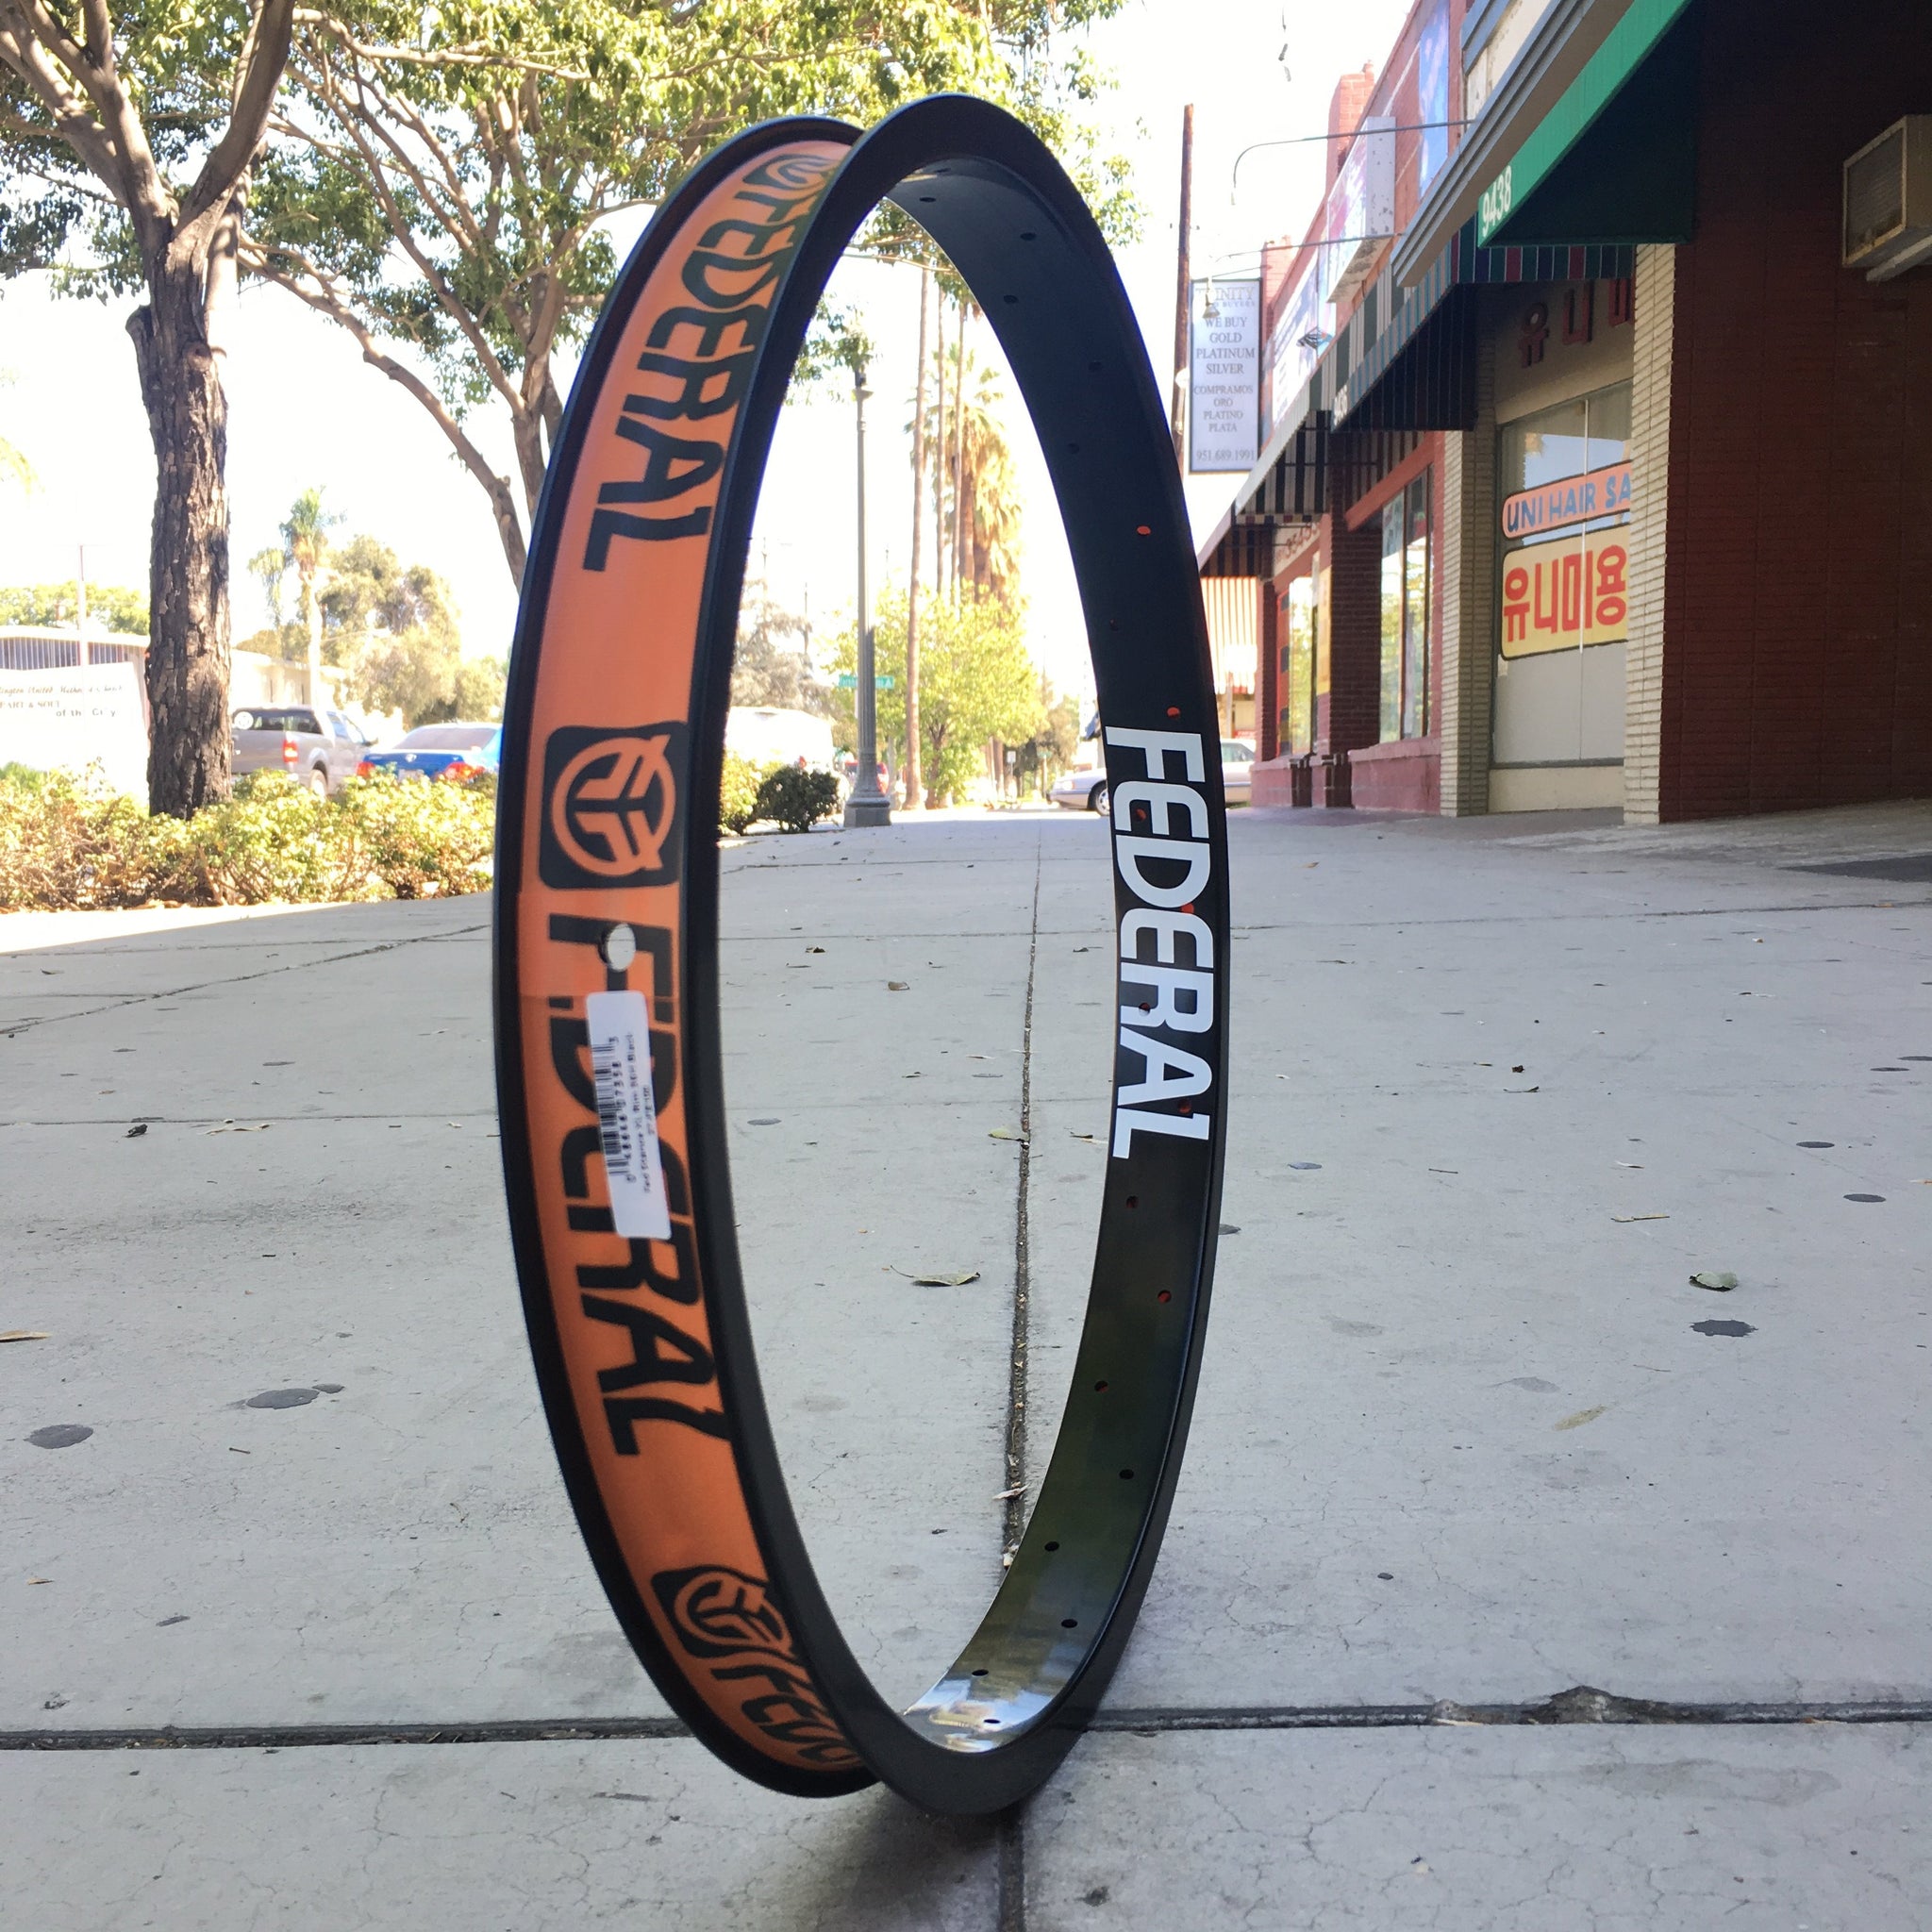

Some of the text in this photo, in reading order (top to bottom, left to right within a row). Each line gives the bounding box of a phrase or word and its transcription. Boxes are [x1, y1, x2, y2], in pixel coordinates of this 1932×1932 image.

[1482, 165, 1512, 238] 9438
[1205, 317, 1247, 327] WE BUY
[1209, 332, 1242, 343] GOLD
[1196, 348, 1256, 359] PLATINUM
[1206, 363, 1244, 375] SILVER
[583, 192, 818, 572] FEDERAL
[1193, 385, 1254, 395] COMPRAMOS
[1213, 397, 1234, 408] ORO
[1203, 411, 1243, 421] PLATINO
[1208, 424, 1238, 433] PLATA
[1507, 495, 1542, 533] UNI
[1549, 482, 1596, 523] HAIR
[1504, 545, 1628, 643] 유니미용
[56, 708, 66, 717] of
[92, 708, 116, 718] Ciy
[1106, 726, 1214, 1159] FEDERAL
[548, 913, 730, 1456] FDERAL
